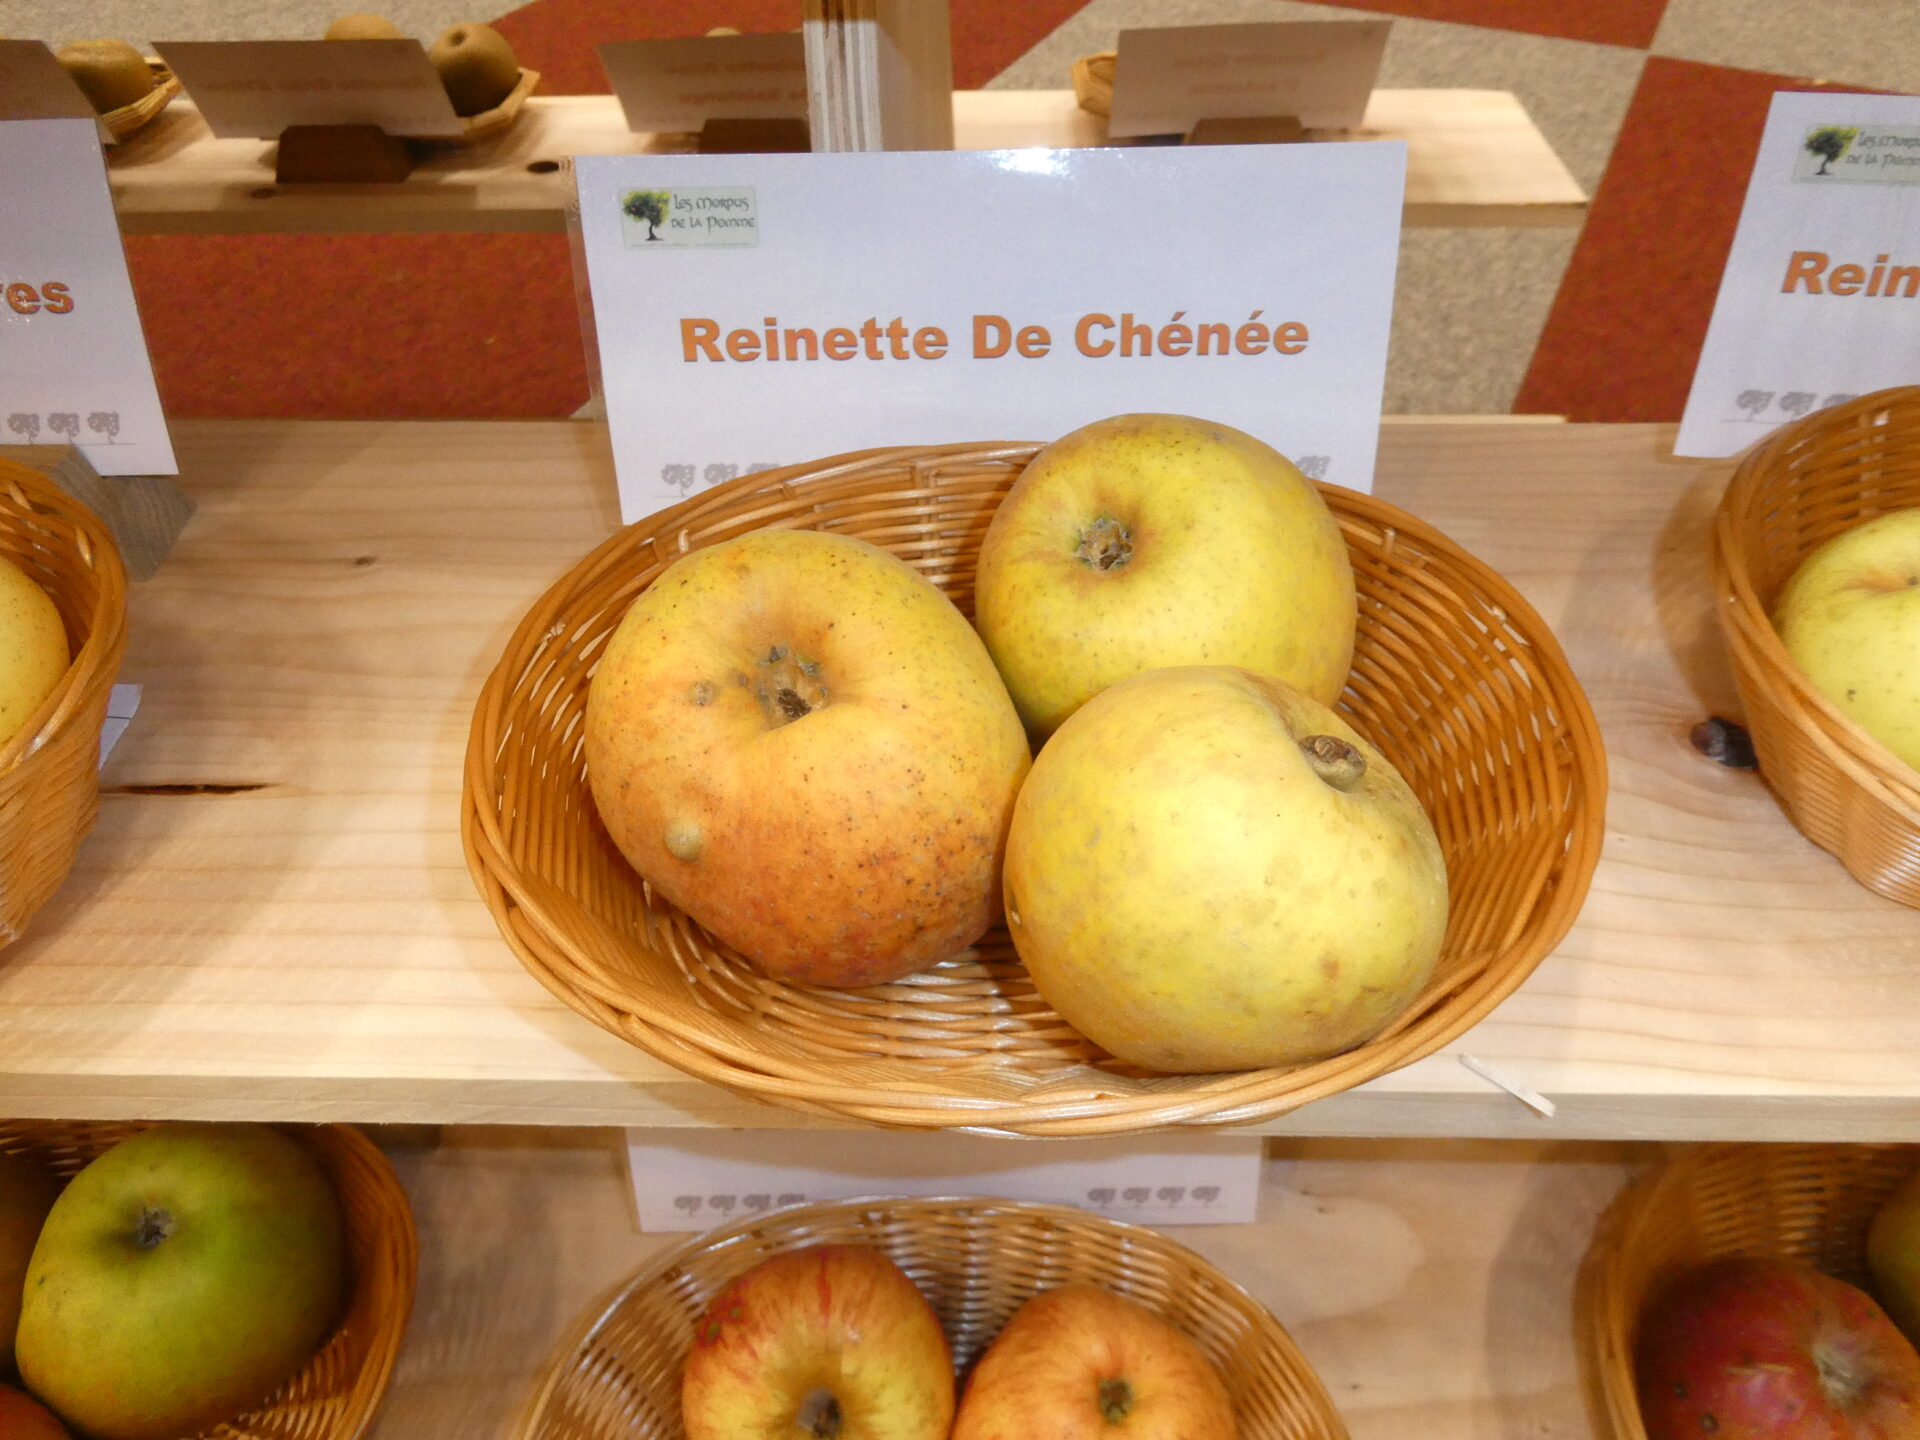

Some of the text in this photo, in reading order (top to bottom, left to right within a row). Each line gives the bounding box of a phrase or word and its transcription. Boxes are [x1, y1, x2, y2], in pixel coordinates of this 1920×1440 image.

[673, 193, 693, 212] Les
[1781, 251, 1920, 297] Rein
[0, 281, 75, 315] es
[680, 311, 1310, 362] Reinette De Chénée
